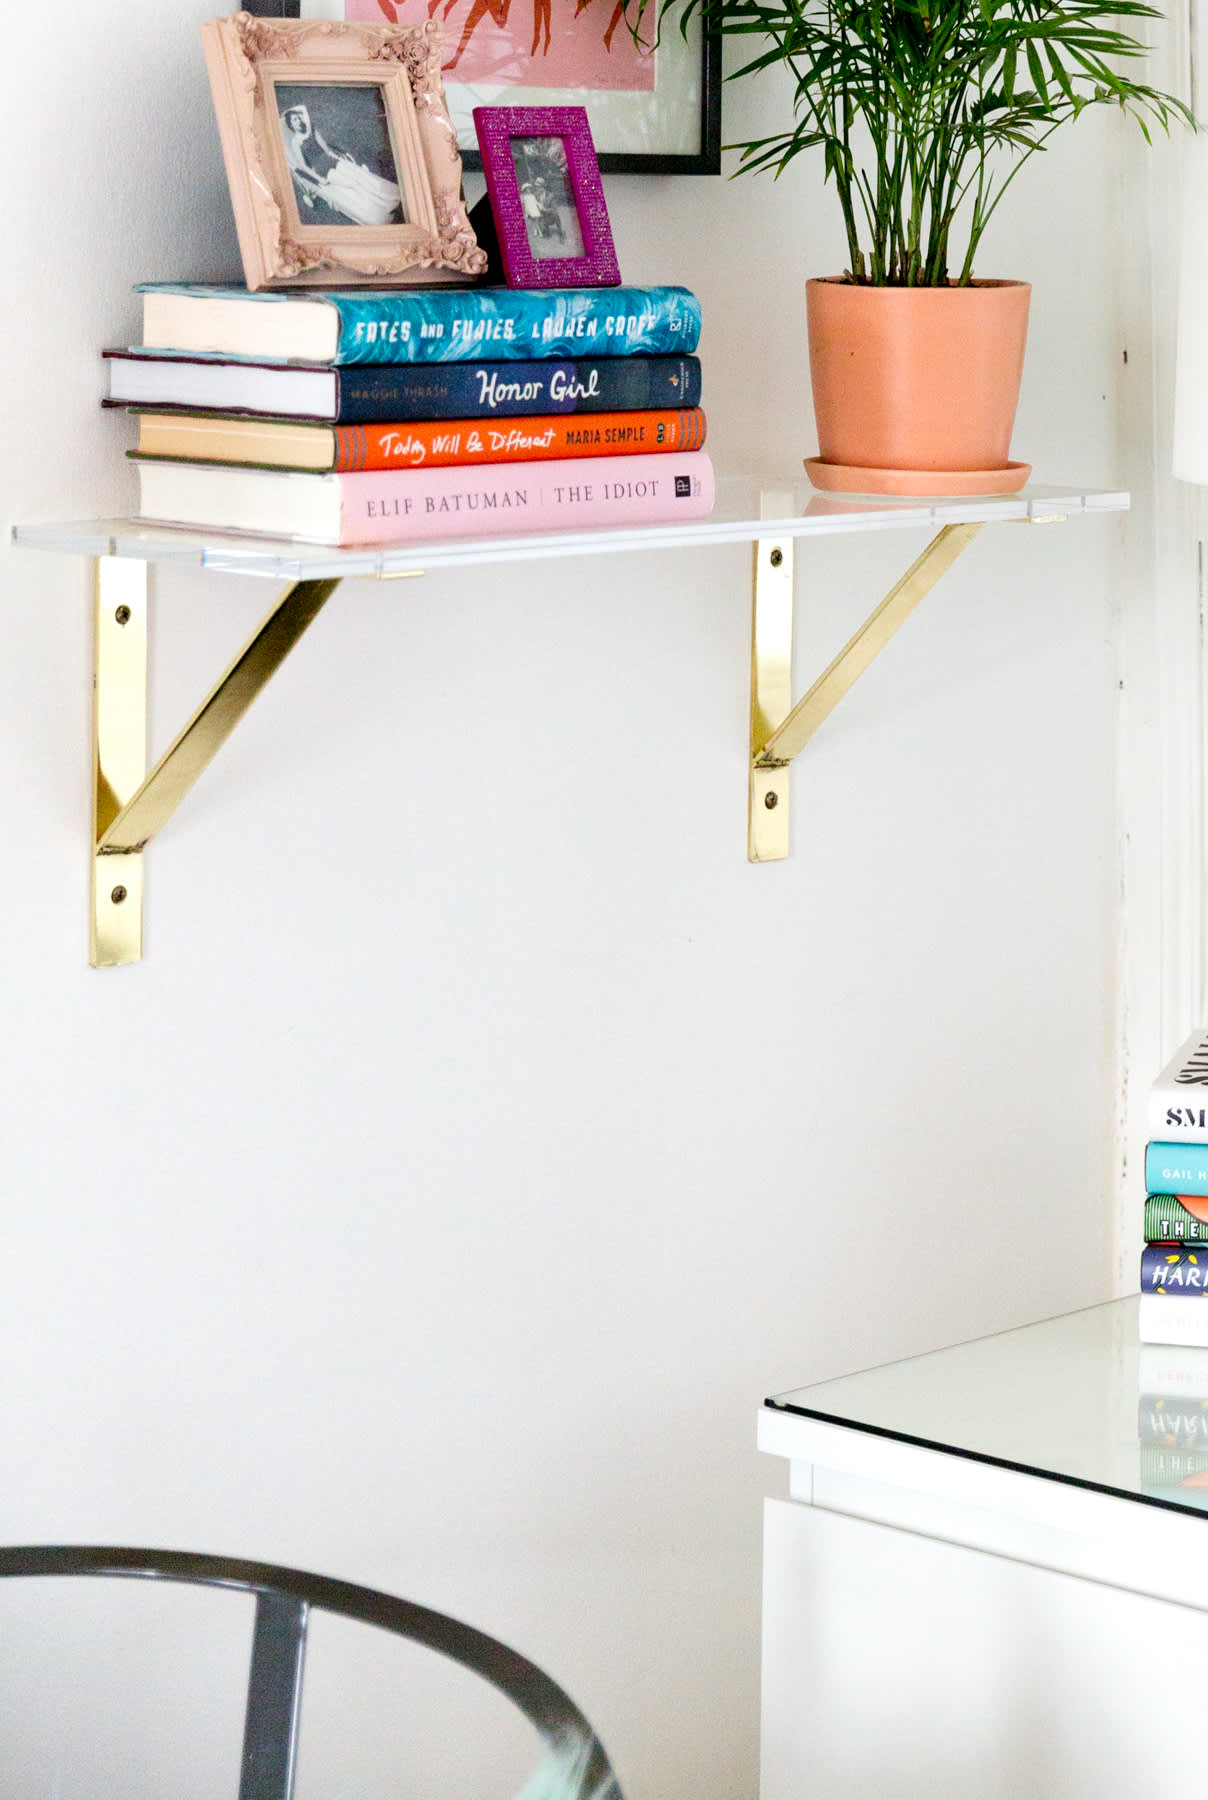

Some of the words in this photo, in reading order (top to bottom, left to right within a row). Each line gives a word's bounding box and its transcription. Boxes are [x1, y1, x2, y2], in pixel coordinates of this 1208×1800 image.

[355, 321, 411, 343] FATES
[420, 323, 444, 339] AND
[452, 319, 514, 340] FURIES
[531, 317, 598, 338] LAUREN
[605, 315, 657, 336] GROFF
[476, 369, 543, 408] Honor
[550, 369, 600, 402] Girl
[378, 432, 426, 464] Today
[432, 434, 461, 455] Will
[466, 431, 484, 453] Be
[488, 428, 557, 452] Different
[566, 430, 601, 445] MARIA
[604, 427, 645, 443] SEMPLE
[366, 497, 413, 518] ELIF
[425, 490, 529, 514] BATUMAN
[553, 485, 594, 503] THE
[604, 480, 660, 501] IDIOT
[1162, 1168, 1193, 1180] GAIL
[1160, 1220, 1200, 1238] THE
